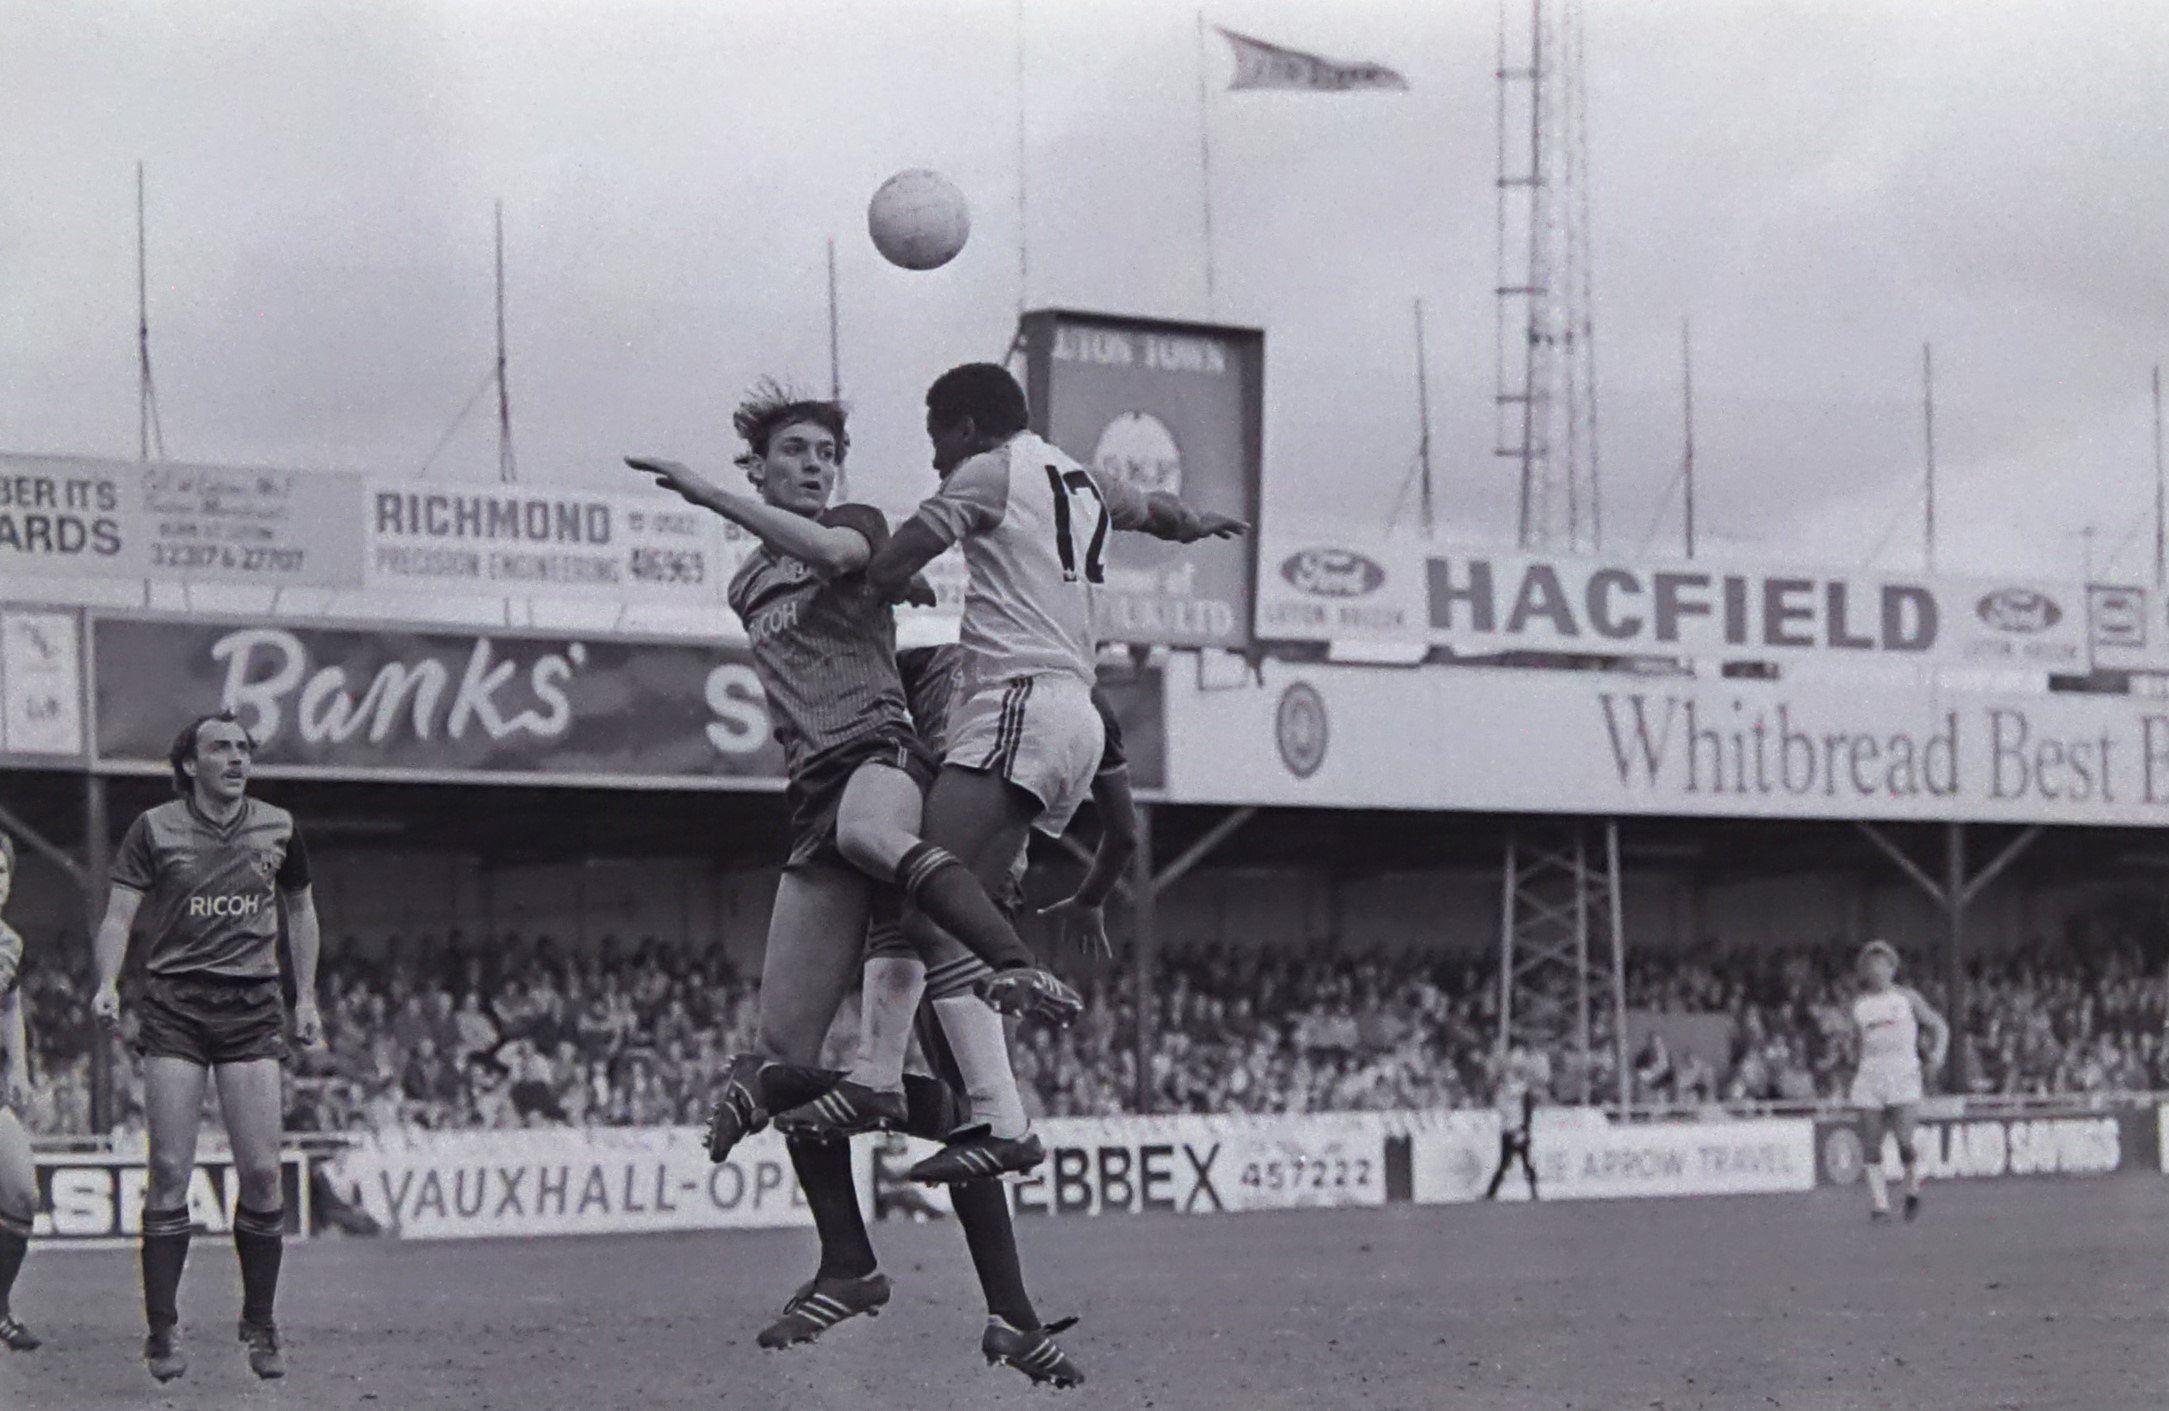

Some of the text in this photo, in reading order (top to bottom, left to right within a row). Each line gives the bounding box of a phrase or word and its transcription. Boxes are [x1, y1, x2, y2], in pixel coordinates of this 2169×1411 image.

[0, 514, 121, 556] ARDS
[376, 493, 611, 544] RICHMOND
[1425, 558, 1938, 650] HACFIELD
[1601, 694, 1957, 798] Whitbread
[1987, 707, 2116, 803] Best
[189, 895, 259, 916] RICOH
